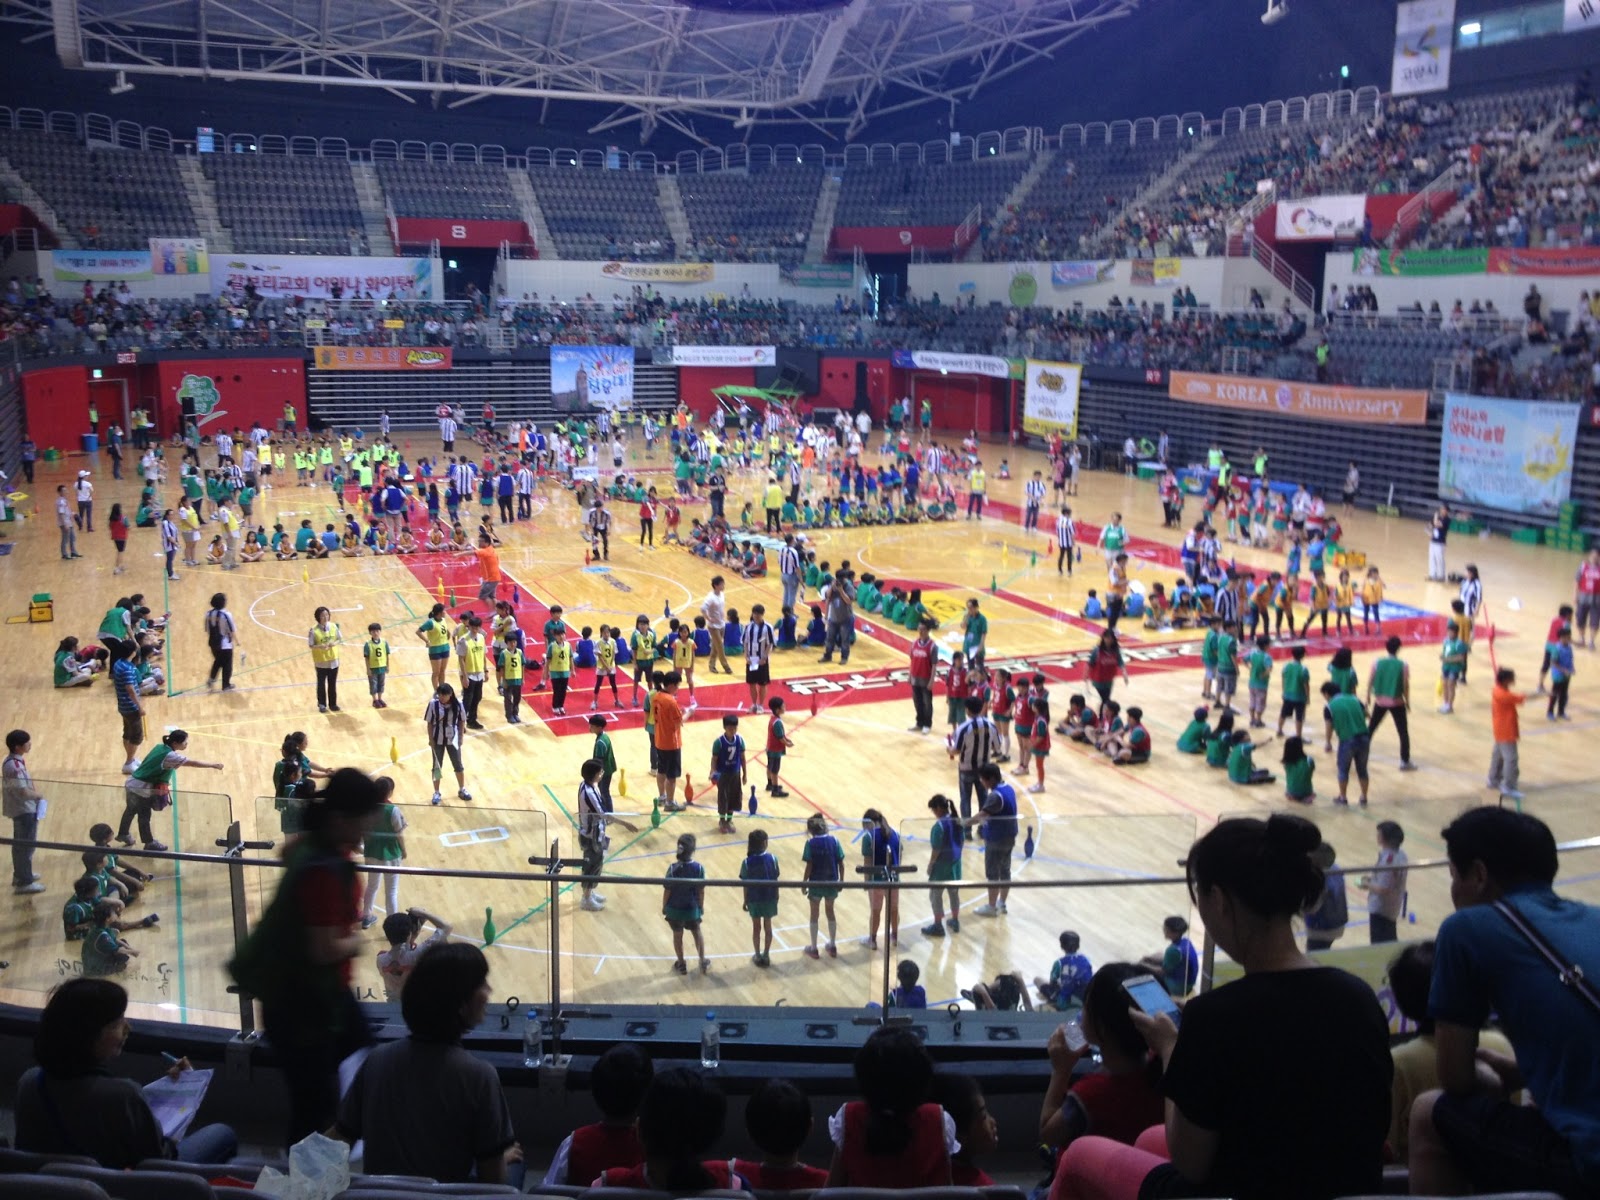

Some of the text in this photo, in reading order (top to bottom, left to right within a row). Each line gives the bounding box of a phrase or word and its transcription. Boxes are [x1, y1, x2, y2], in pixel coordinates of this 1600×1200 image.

[451, 225, 467, 239] 8
[1216, 382, 1269, 403] KOREA
[1299, 389, 1403, 418] Anniversary
[375, 648, 382, 658] 6
[559, 651, 565, 660] 4
[605, 649, 611, 658] 3
[511, 658, 518, 667] 5
[727, 746, 737, 760] 7
